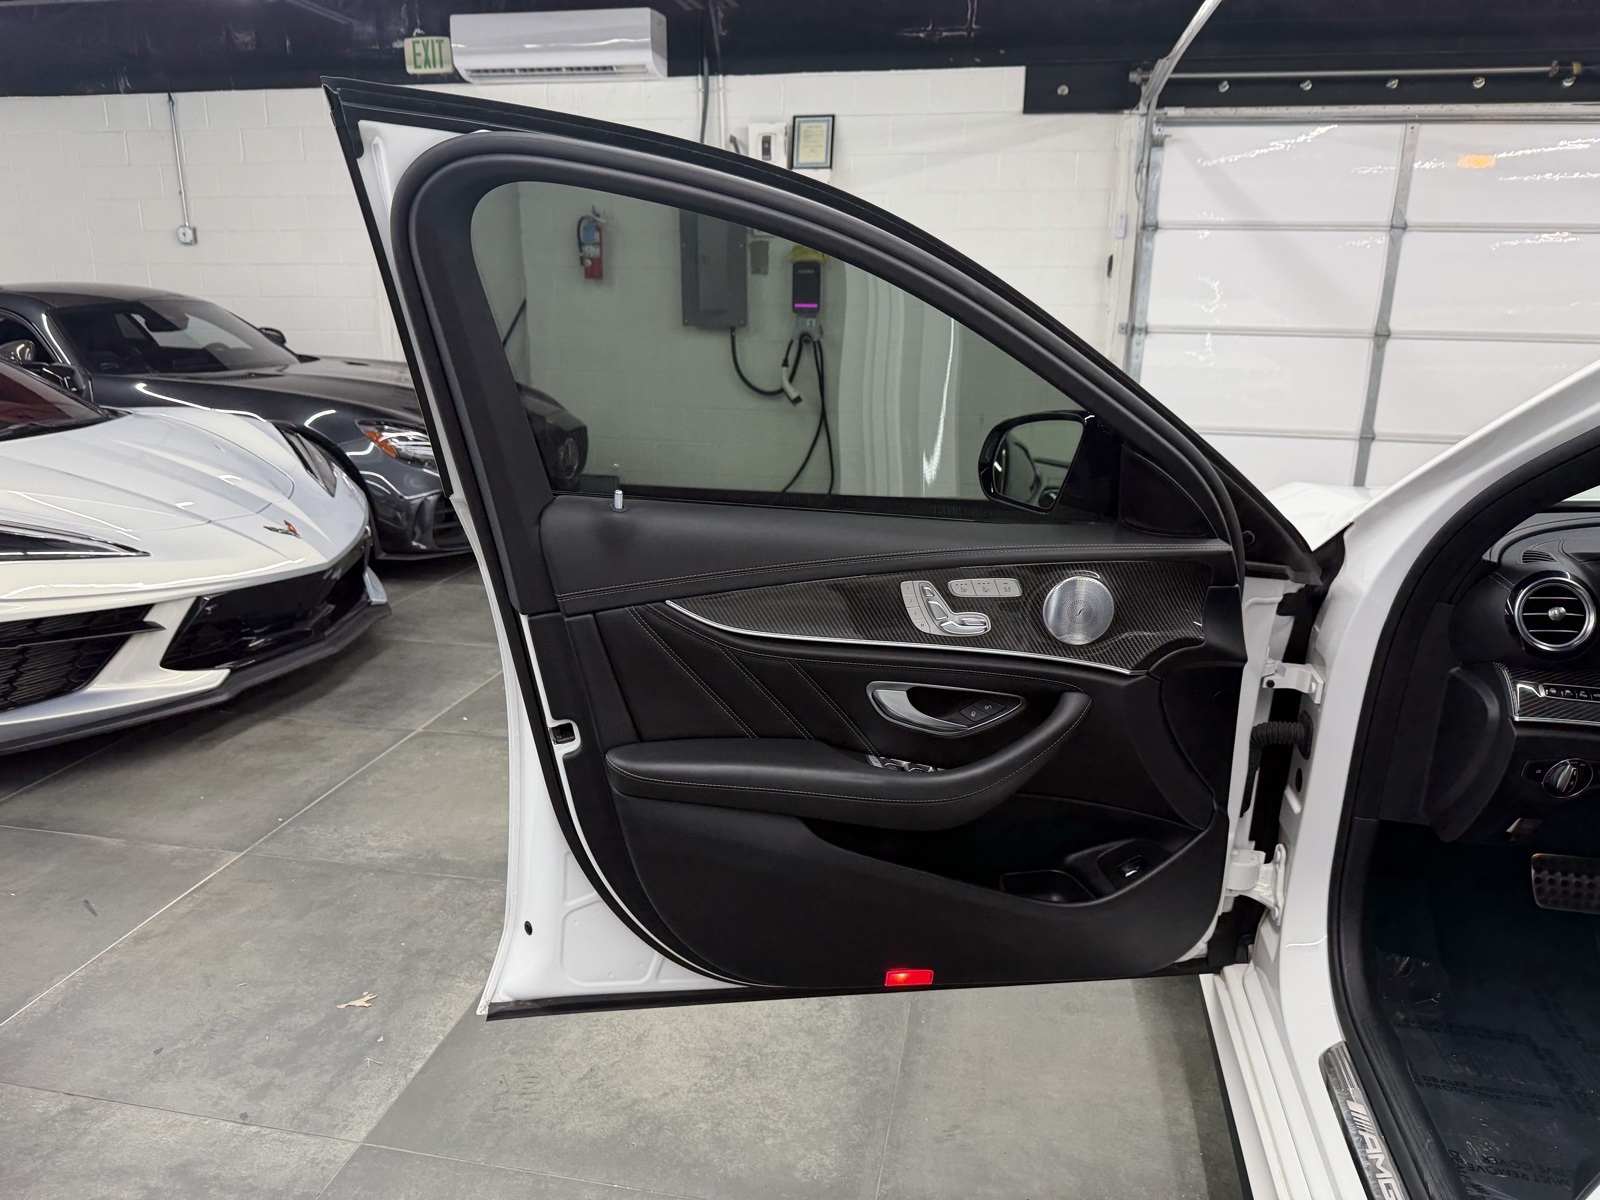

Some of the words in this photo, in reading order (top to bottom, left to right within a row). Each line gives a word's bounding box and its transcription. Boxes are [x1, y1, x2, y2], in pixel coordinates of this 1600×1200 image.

[412, 39, 445, 70] EXIT
[1357, 1130, 1405, 1200] AMG
[1466, 1162, 1529, 1181] REMOVE
